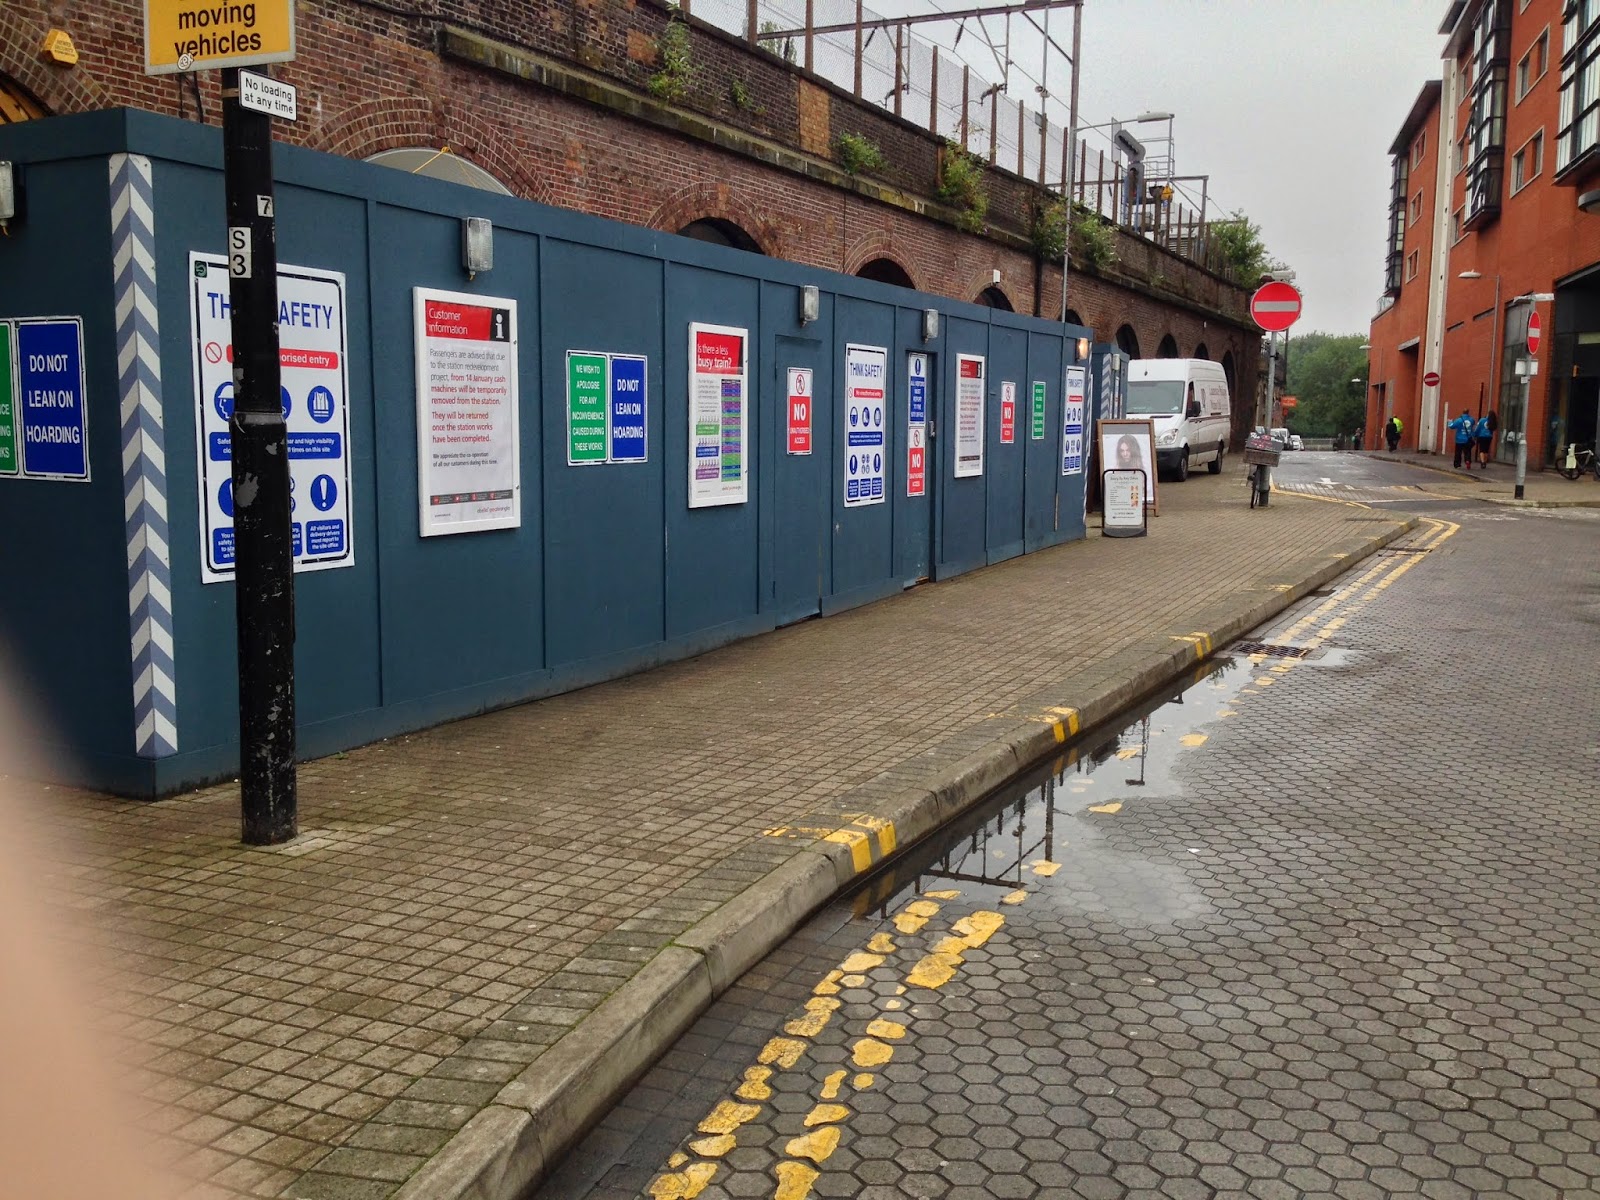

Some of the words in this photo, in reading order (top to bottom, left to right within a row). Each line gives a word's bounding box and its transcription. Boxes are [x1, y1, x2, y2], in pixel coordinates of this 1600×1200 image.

[178, 2, 256, 30] moving
[174, 30, 262, 58] vehicles
[246, 78, 258, 90] No
[261, 82, 292, 102] loading
[244, 93, 253, 103] at
[257, 96, 272, 109] any
[275, 100, 293, 114] time
[260, 197, 270, 214] 7
[233, 230, 246, 249] S
[233, 254, 246, 276] 3
[278, 300, 332, 329] AFETY
[429, 308, 461, 320] Customer
[429, 322, 468, 334] information
[430, 349, 457, 359] Passengers
[468, 351, 485, 359] advised
[702, 344, 715, 354] there
[720, 345, 729, 355] less
[30, 355, 44, 372] DO
[47, 354, 68, 372] NOT
[309, 354, 330, 366] entry
[437, 361, 446, 369] the
[447, 362, 464, 370] station
[465, 363, 499, 372] redevelopment
[697, 355, 713, 370] busy
[714, 357, 732, 368] train?
[850, 363, 864, 376] THINK
[865, 364, 882, 377] SAFETY
[451, 373, 464, 381] from
[473, 375, 493, 384] January
[617, 379, 626, 391] DO
[627, 380, 639, 391] NOT
[29, 390, 56, 407] LEAN
[58, 391, 73, 407] ON
[477, 387, 507, 396] temporarily
[432, 411, 444, 421] They
[447, 411, 457, 419] will
[458, 411, 465, 419] be
[616, 403, 631, 415] LEAN
[632, 403, 641, 415] ON
[794, 404, 806, 421] NO
[447, 423, 456, 431] the
[457, 423, 475, 431] station
[614, 426, 643, 438] HOARDING
[26, 426, 80, 443] HOARDING
[447, 435, 460, 443] been
[912, 454, 921, 468] NO
